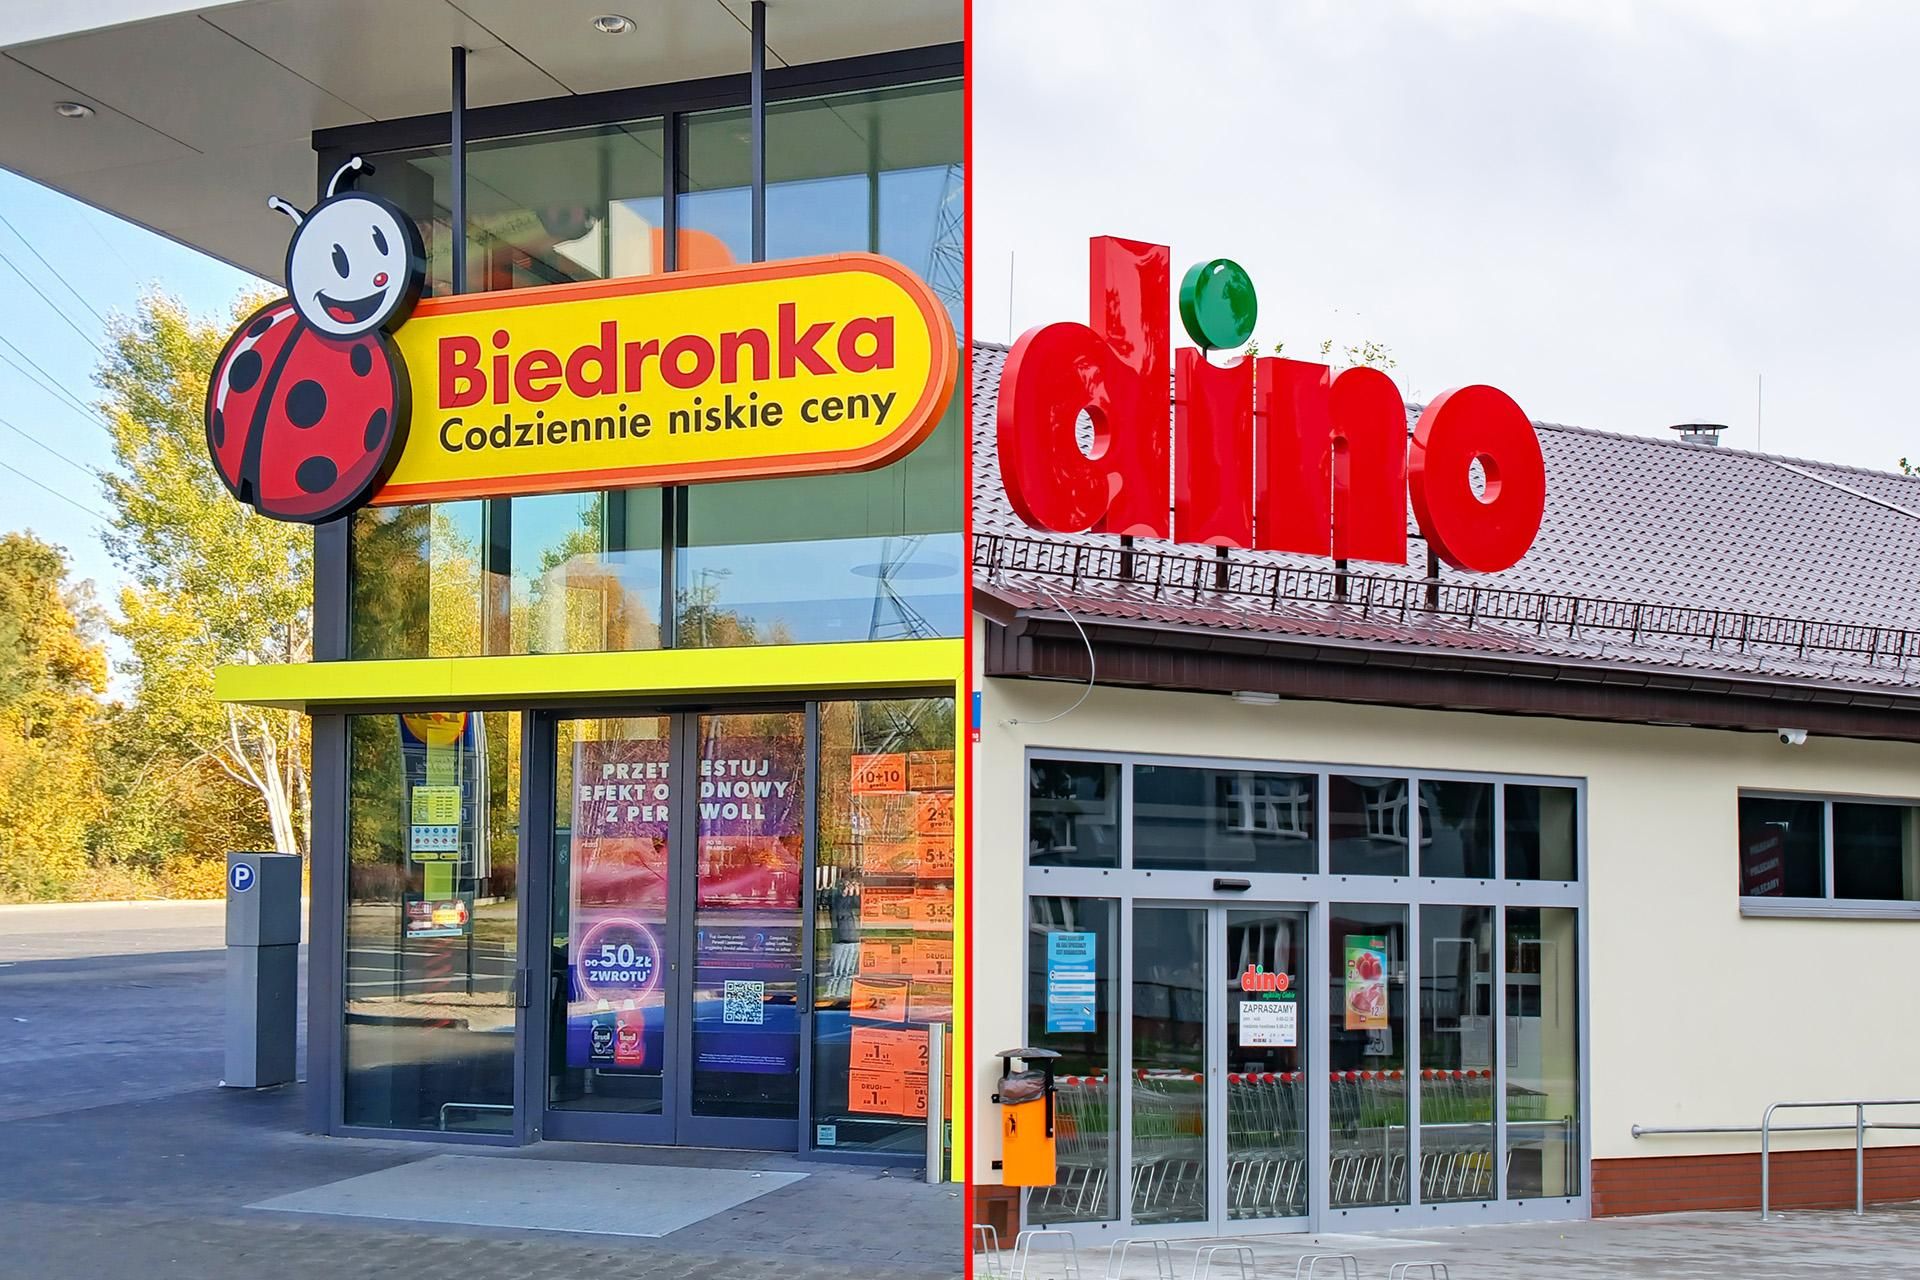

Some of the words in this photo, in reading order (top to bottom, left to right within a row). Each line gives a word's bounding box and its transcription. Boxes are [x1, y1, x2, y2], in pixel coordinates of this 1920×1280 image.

[439, 302, 895, 409] Biedronka
[997, 235, 1546, 573] dino
[439, 403, 651, 452] Codziennie
[669, 392, 783, 434] niskie
[800, 391, 897, 425] ceny
[602, 762, 670, 780] PRZET
[700, 759, 769, 777] ESTUJ
[860, 770, 900, 783] 10+10
[580, 784, 647, 802] EFEKT
[654, 783, 670, 801] O
[700, 781, 789, 798] DNOWY
[606, 806, 618, 823] Z
[627, 805, 670, 822] PER
[700, 803, 766, 820] WOLL
[235, 866, 250, 887] P
[600, 944, 635, 968] 50
[635, 956, 652, 968] ZŁ
[1241, 964, 1289, 991] dino
[1243, 1004, 1294, 1014] ZAPRASZAMY
